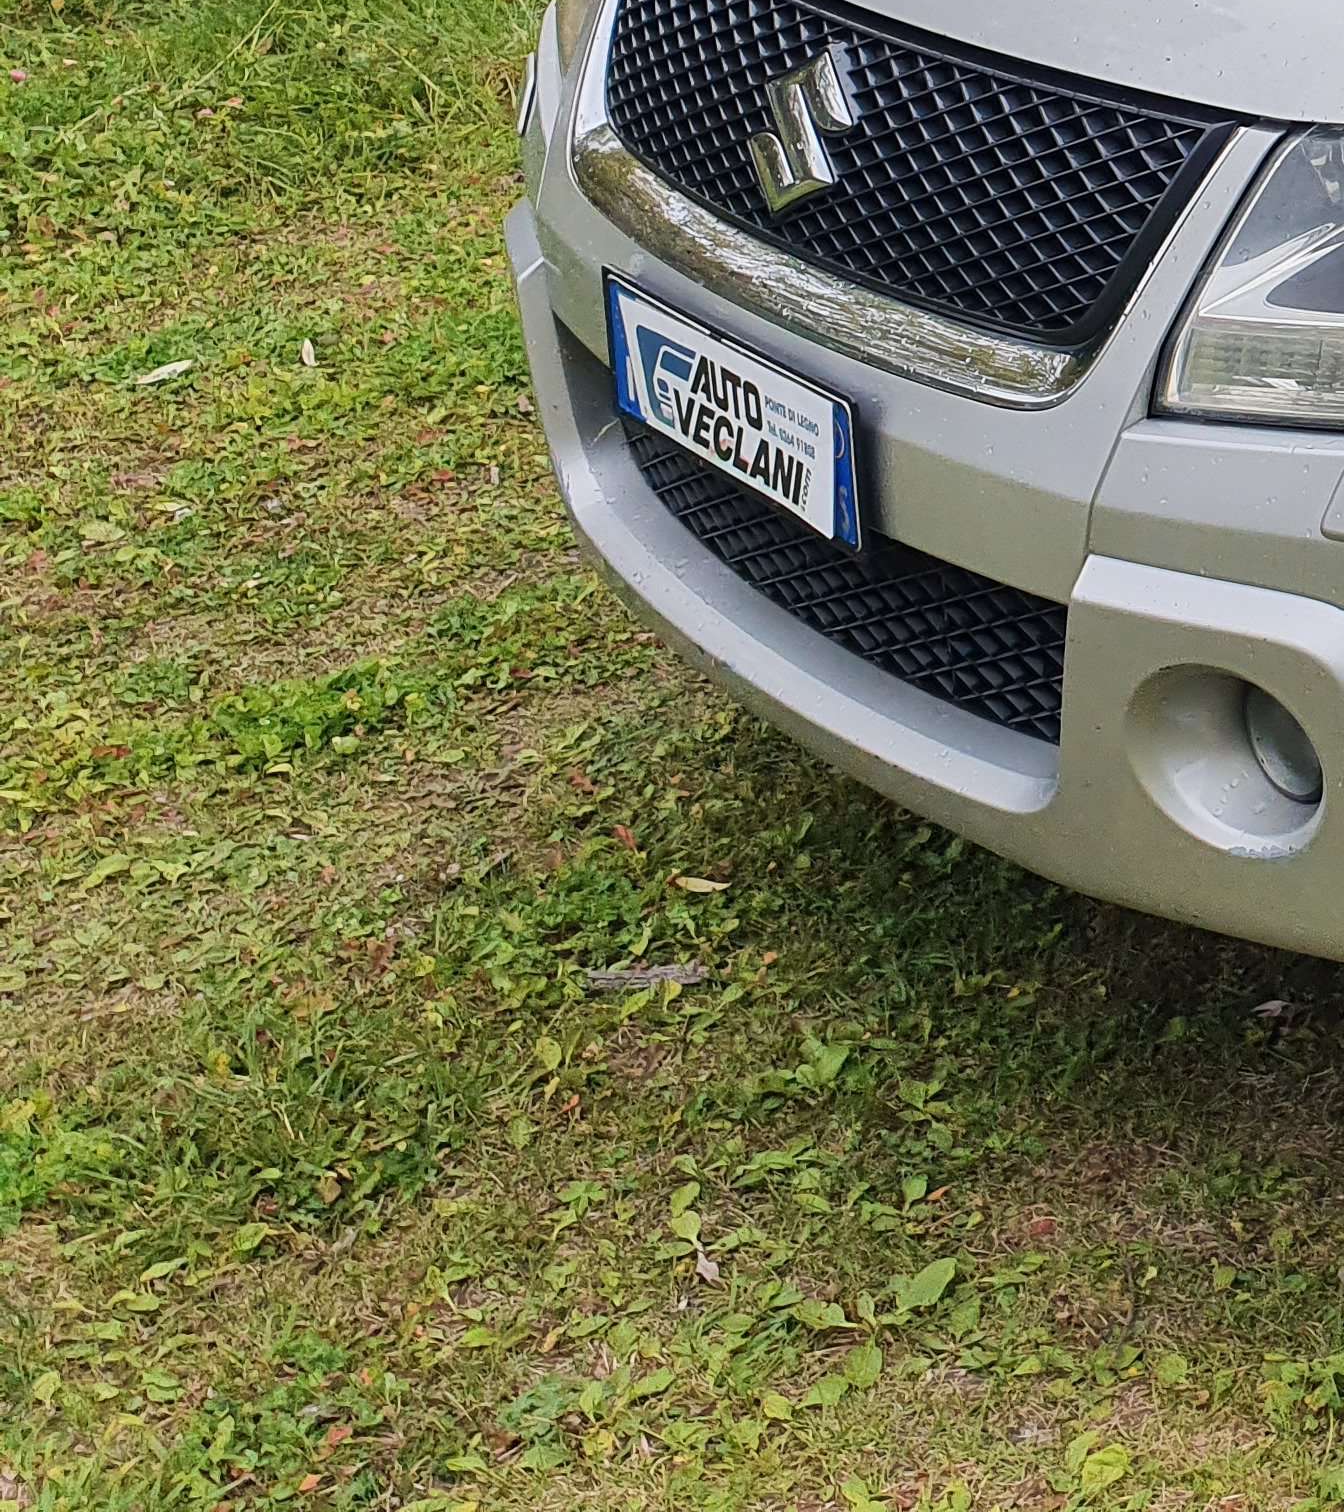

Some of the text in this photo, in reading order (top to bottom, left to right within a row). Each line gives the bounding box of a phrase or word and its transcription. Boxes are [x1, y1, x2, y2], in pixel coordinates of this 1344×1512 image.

[690, 354, 763, 432] AUTO
[764, 394, 787, 419] PONTE
[673, 386, 804, 507] VECLANI
